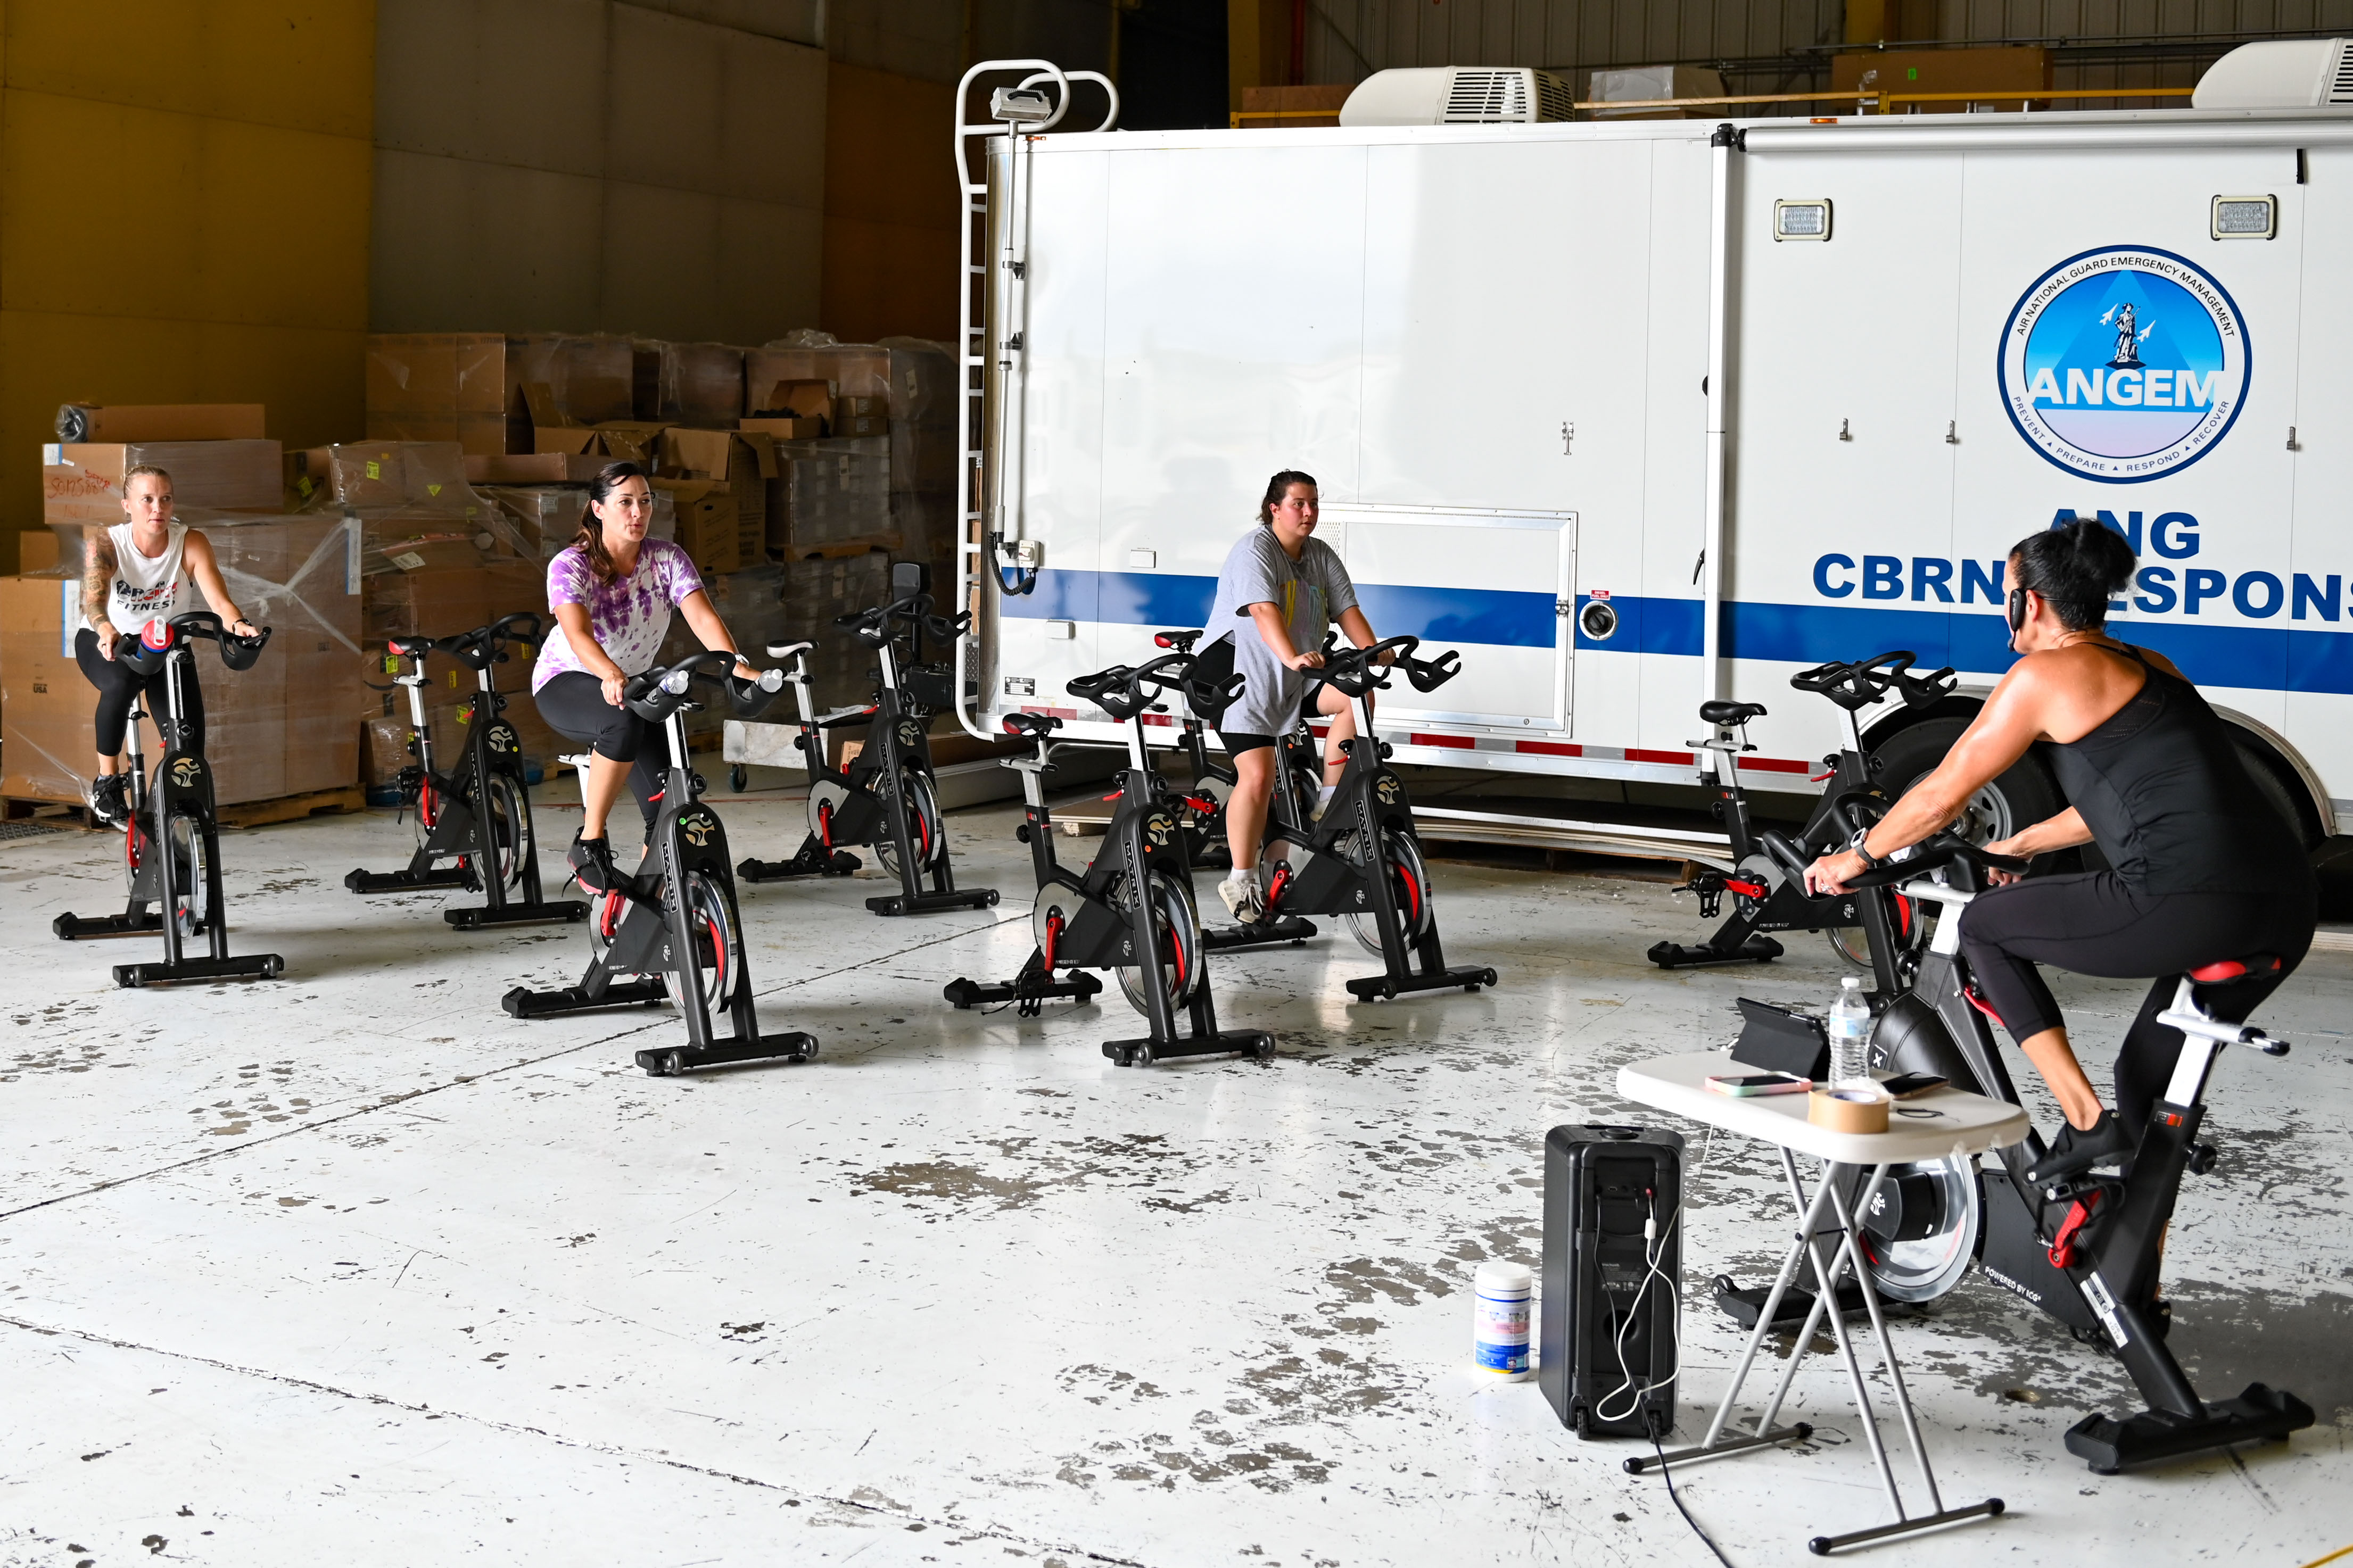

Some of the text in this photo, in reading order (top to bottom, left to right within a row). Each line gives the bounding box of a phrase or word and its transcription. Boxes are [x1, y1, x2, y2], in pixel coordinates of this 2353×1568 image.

[2017, 257, 2235, 337] AIR NATIONAL GUARD EMERGENCY MANAGEMENT
[2026, 368, 2225, 406] ANGEM
[2013, 396, 2229, 472] PREVENT PREPARE RESPOND RECOVER
[1813, 553, 2353, 621] CBRN SPON
[471, 752, 480, 800] MATRIX
[882, 746, 893, 792] MATRIX
[1357, 804, 1372, 857] MATRIX
[663, 845, 675, 908] MATRIX
[1126, 844, 1139, 905] MATRIX
[1985, 1266, 2017, 1290] POWERED
[2016, 1284, 2027, 1295] BY
